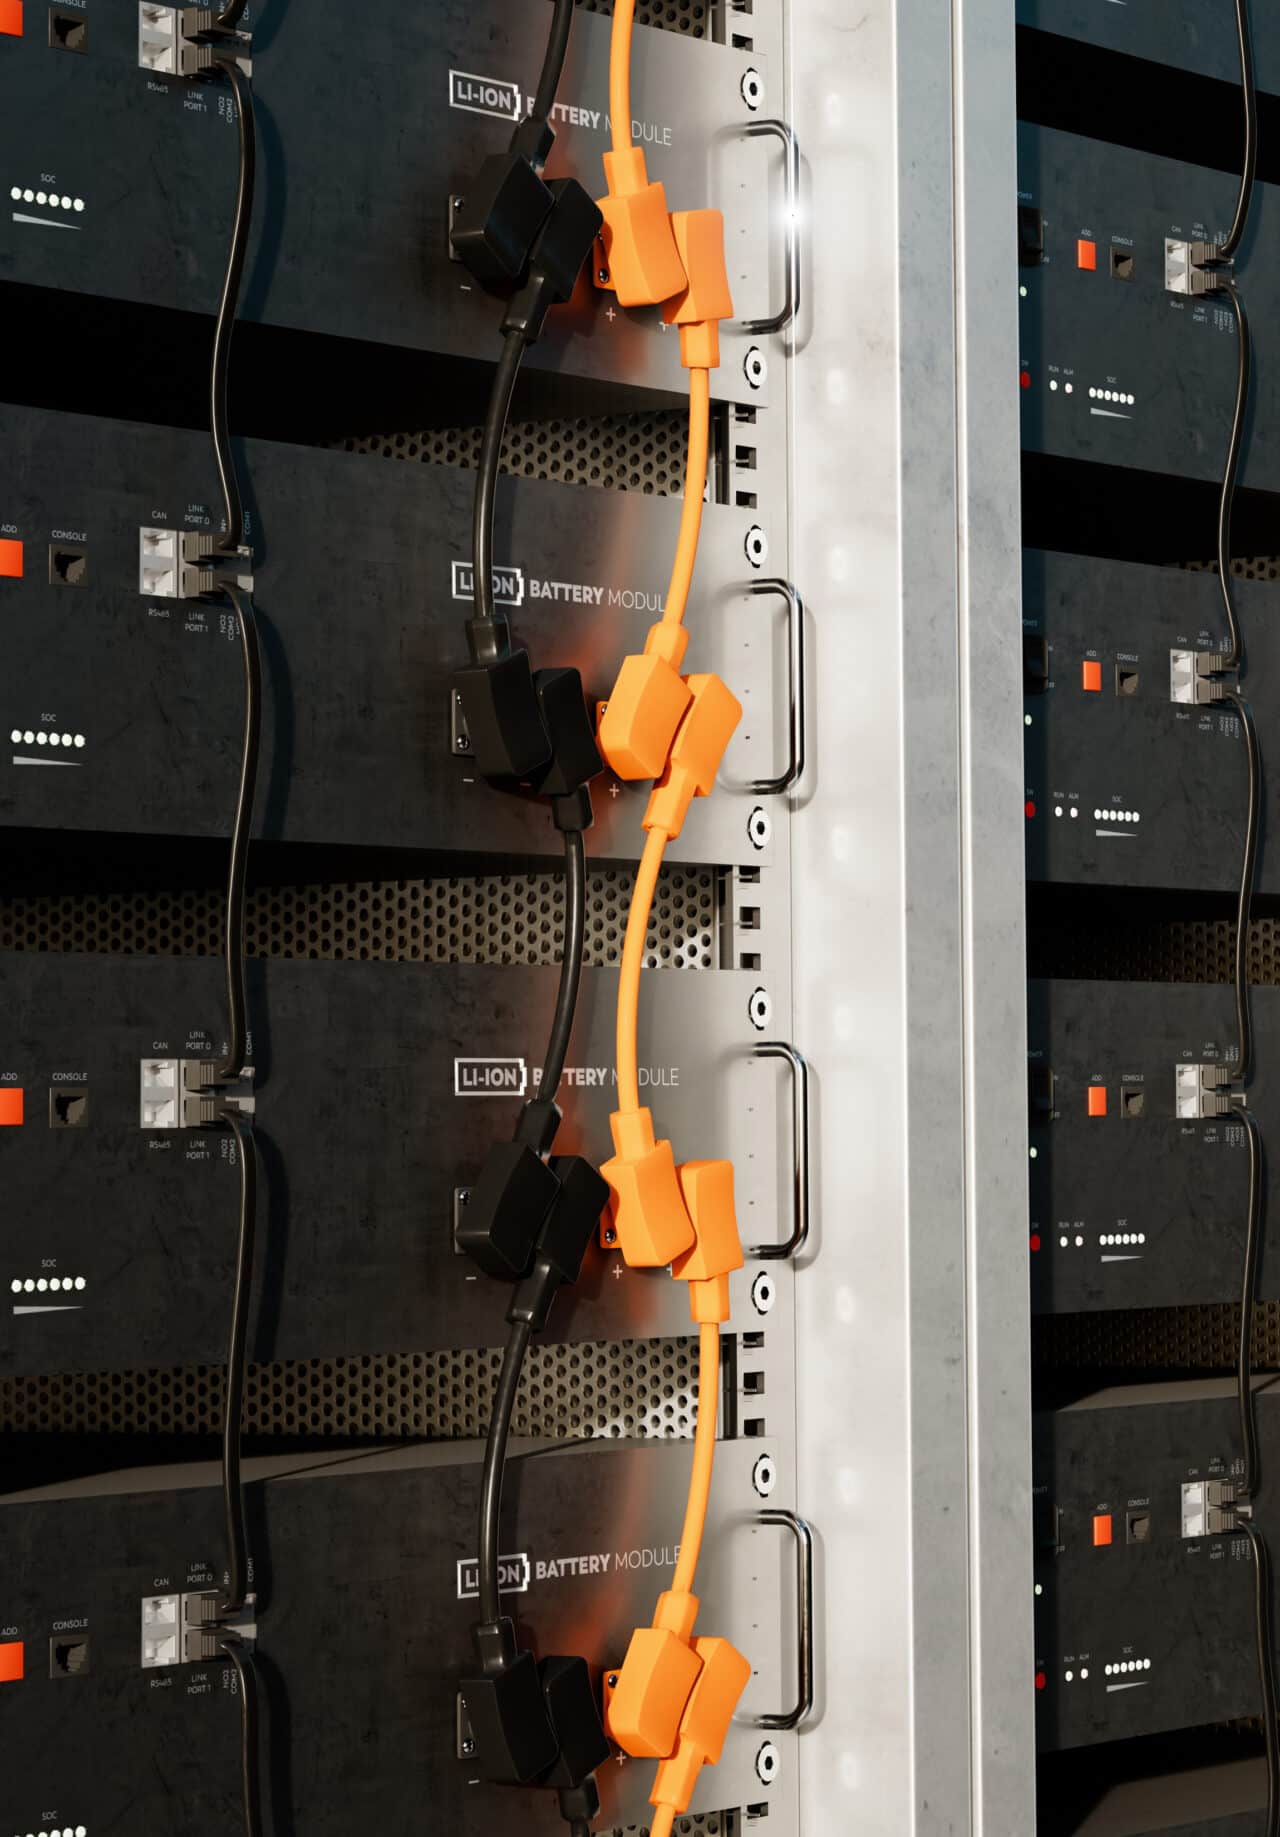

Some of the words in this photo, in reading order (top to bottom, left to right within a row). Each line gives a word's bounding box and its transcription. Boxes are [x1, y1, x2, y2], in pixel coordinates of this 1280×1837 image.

[456, 80, 512, 110] LI-ION
[184, 101, 202, 112] PORT
[40, 173, 57, 184] SOC
[151, 510, 168, 521] CAN
[184, 514, 202, 524] PORT
[0, 525, 18, 534] ADD
[51, 530, 88, 542] CONSOLE
[529, 579, 605, 605] BATTERY
[608, 589, 665, 612] MODUL
[184, 623, 203, 633] PORT
[41, 713, 57, 722] SOC
[152, 1041, 168, 1050] CAN
[185, 1042, 204, 1050] PORT
[0, 1072, 18, 1081] ADD
[51, 1072, 88, 1081] CONSOLE
[462, 1067, 518, 1086] LI-ION
[186, 1151, 205, 1160] PORT
[535, 1553, 611, 1580] BATTERY
[153, 1578, 169, 1587] CAN
[186, 1574, 205, 1584] PORT
[52, 1618, 88, 1631] CONSOLE
[0, 1626, 18, 1636] ADD
[187, 1685, 206, 1695] PORT
